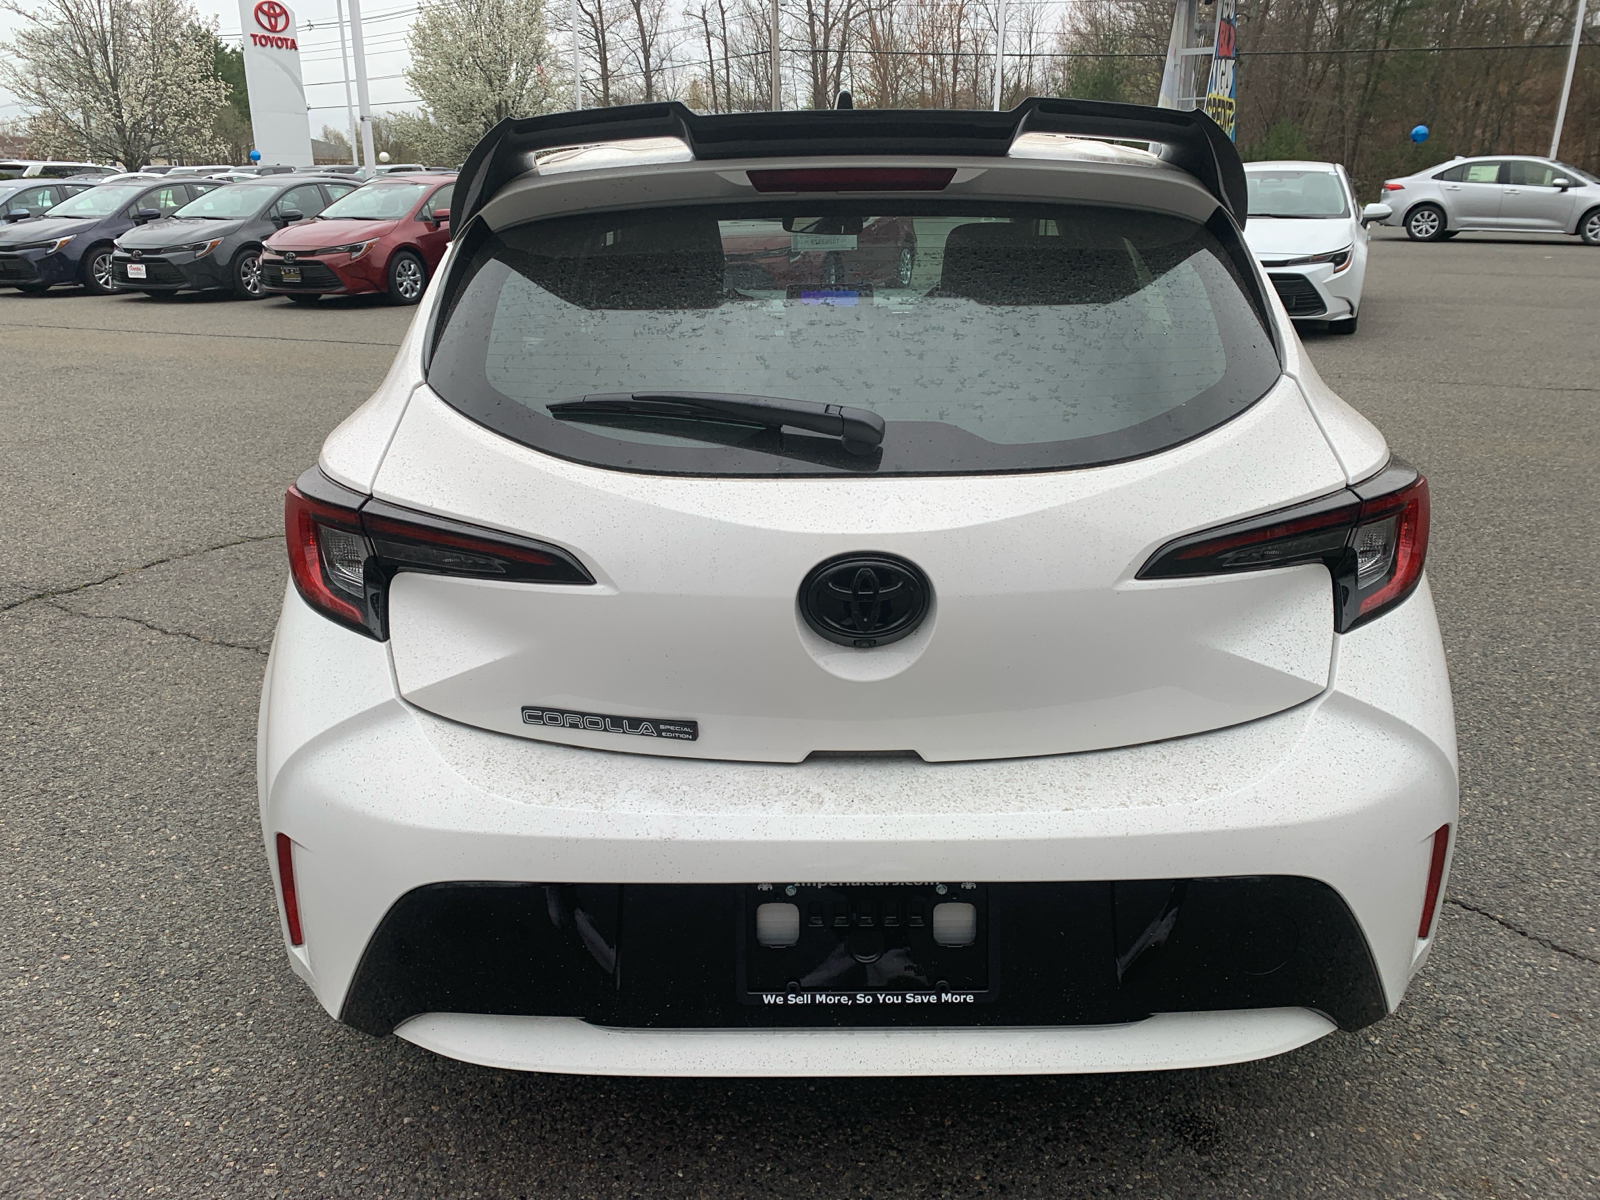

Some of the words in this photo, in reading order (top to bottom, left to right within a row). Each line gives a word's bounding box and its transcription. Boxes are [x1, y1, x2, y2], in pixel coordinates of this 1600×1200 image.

[250, 33, 298, 51] TOYOTA
[522, 710, 657, 737] COROLLA
[660, 724, 693, 732] SPECIAL
[662, 731, 692, 739] EDITION
[762, 994, 784, 1004] We
[787, 993, 811, 1004] Sell
[815, 993, 852, 1006] More,
[856, 993, 873, 1004] So
[877, 993, 901, 1004] You
[905, 993, 937, 1003] Save
[941, 992, 974, 1003] More
